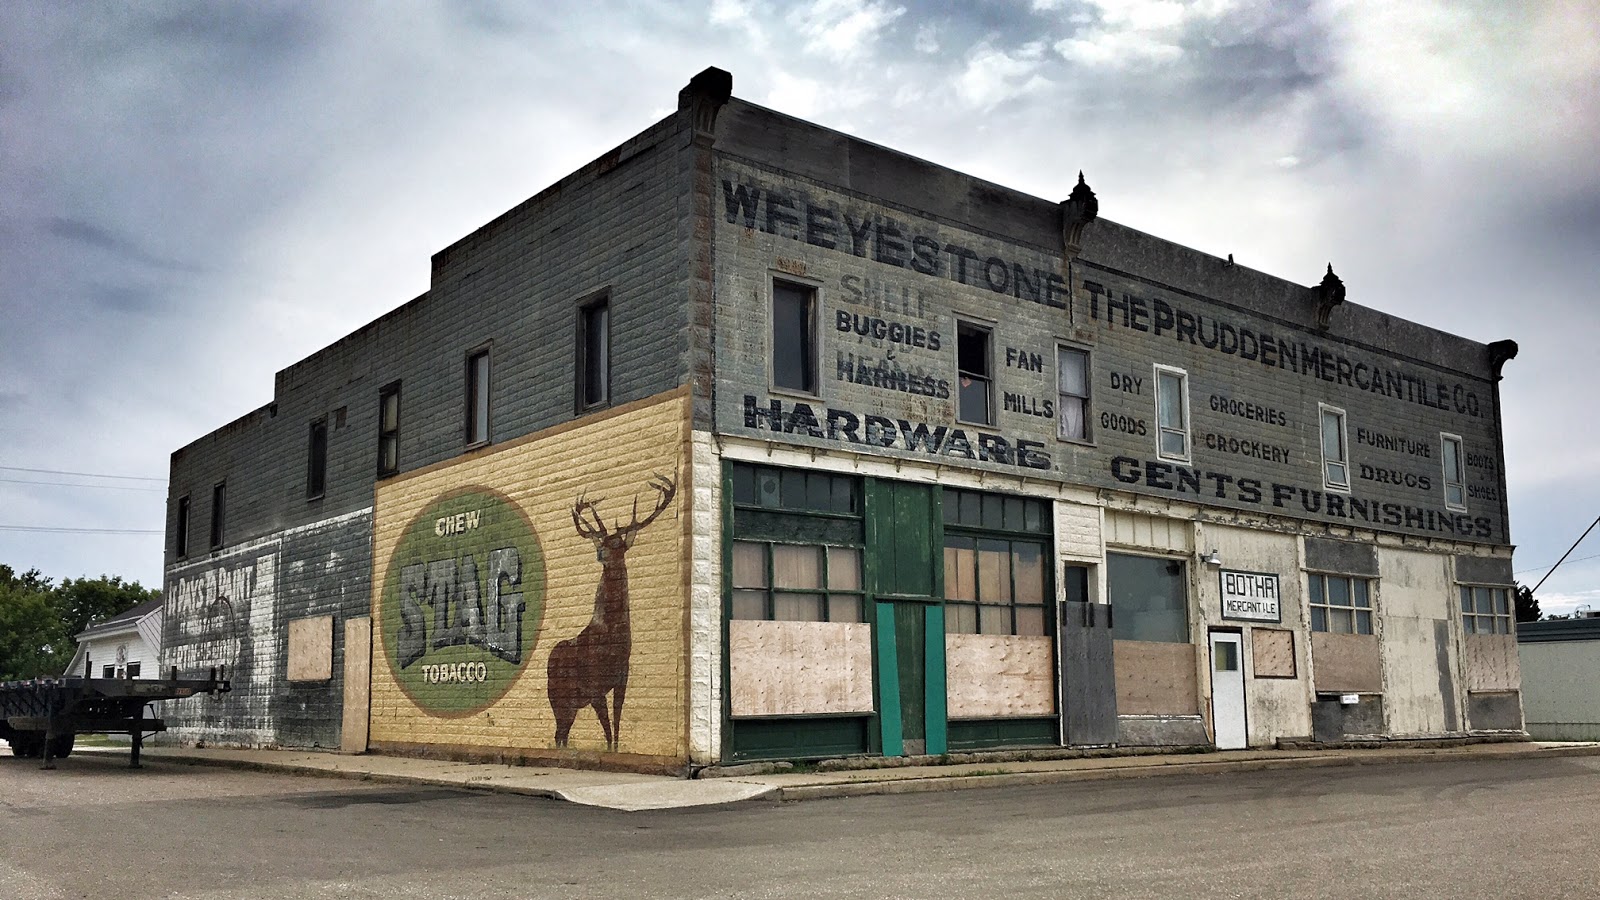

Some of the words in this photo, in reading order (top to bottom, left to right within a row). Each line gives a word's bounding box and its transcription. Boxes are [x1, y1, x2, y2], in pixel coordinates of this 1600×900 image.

[836, 309, 941, 351] BUGGIES
[1006, 346, 1043, 373] FAN
[1083, 279, 1150, 333] THE
[1153, 298, 1299, 376] PRUDDEN
[1301, 342, 1450, 412] MERCANTILE
[836, 355, 950, 400] HARNESS
[1110, 371, 1143, 395] DRY
[1003, 391, 1054, 419] MILLS
[1209, 394, 1287, 427] GROCERIES
[743, 394, 1052, 471] HARDWARE
[1100, 411, 1147, 436] GOODS
[1206, 433, 1290, 464] CROCKERY
[1357, 427, 1431, 458] FURNITURE
[1467, 451, 1494, 471] BOOTS
[1359, 462, 1432, 491] DRUGS
[1110, 455, 1262, 504] GENTS
[1271, 482, 1492, 539] FURNISHINGS
[1467, 484, 1497, 501] SHOES
[435, 509, 481, 537] CHEW
[1225, 573, 1275, 598] BOTHA
[396, 546, 527, 670] STAG
[1226, 599, 1276, 614] MERCANTILE
[421, 661, 488, 684] TOBACCO
